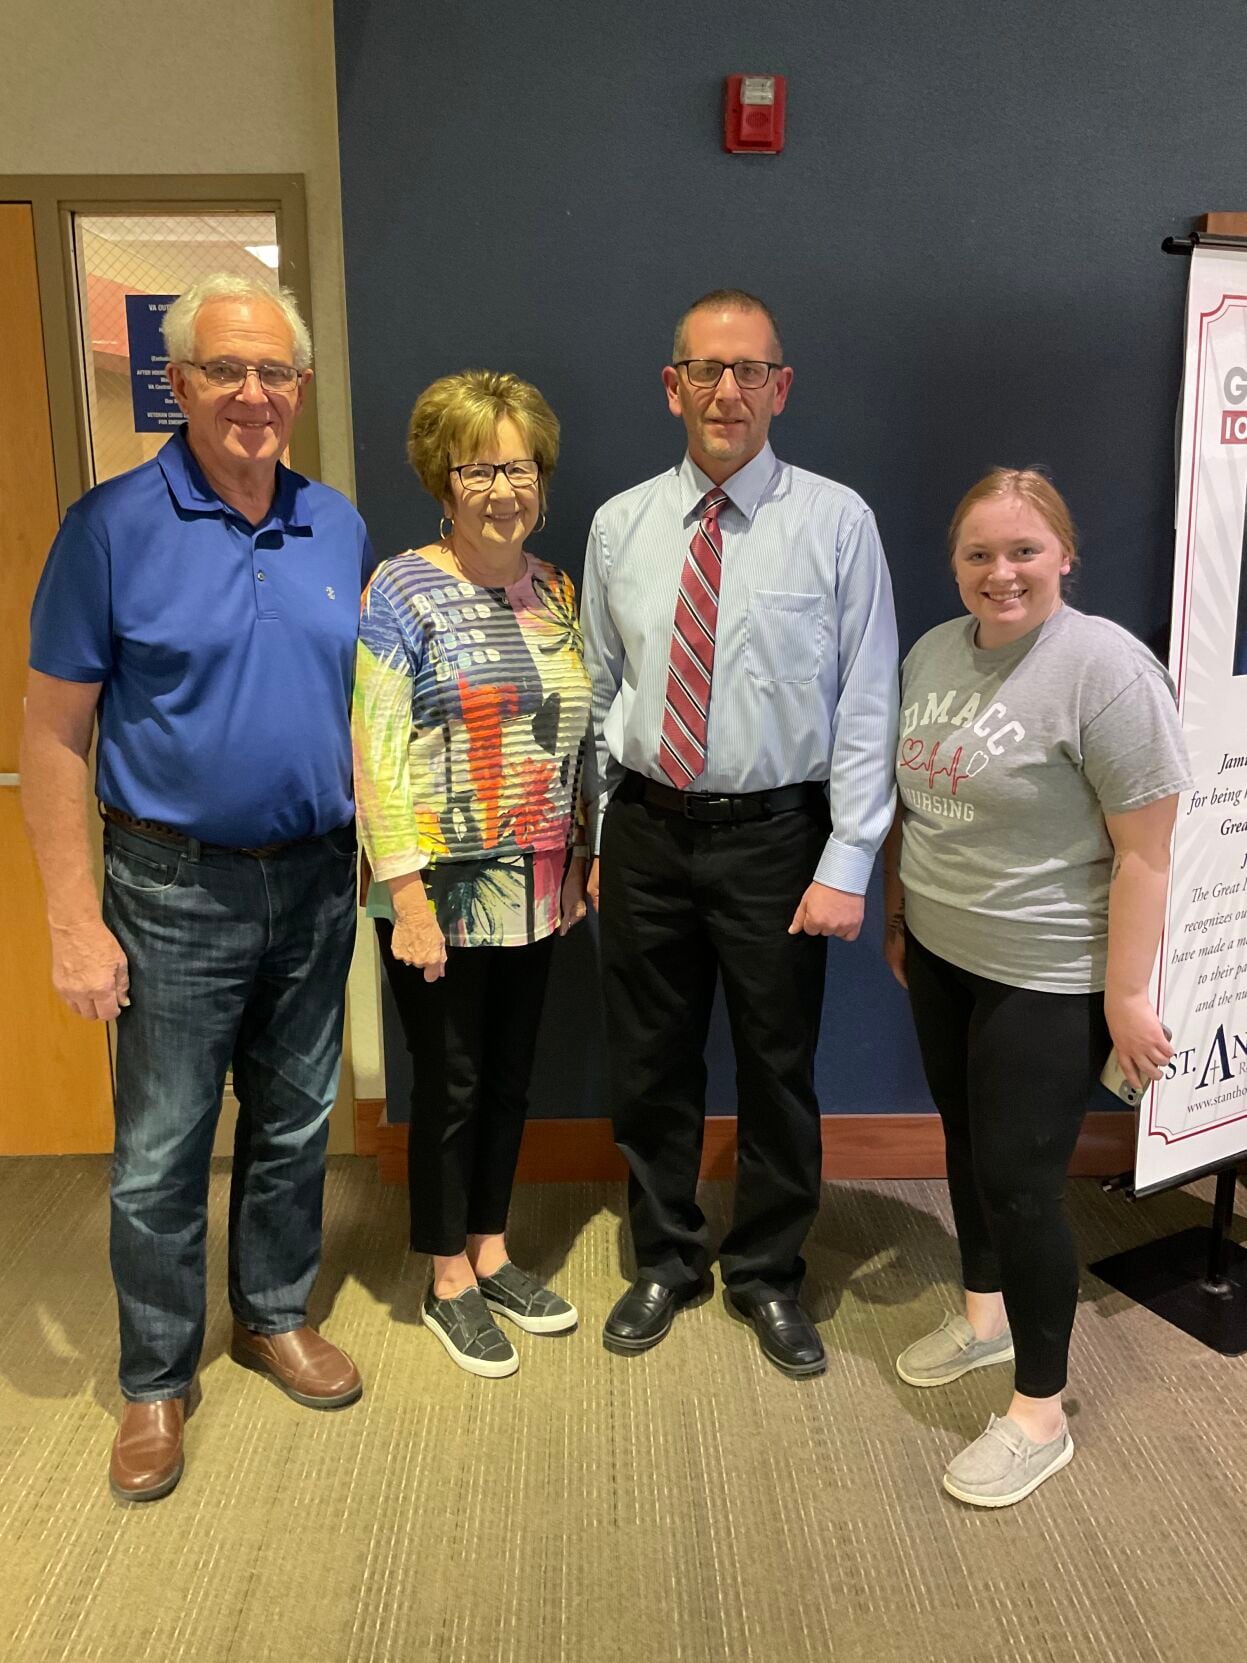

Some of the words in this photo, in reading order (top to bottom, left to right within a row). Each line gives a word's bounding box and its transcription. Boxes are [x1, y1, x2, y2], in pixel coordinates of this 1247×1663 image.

[902, 690, 1026, 755] DMACC
[902, 787, 975, 822] NURSING
[1186, 790, 1208, 815] for
[1210, 787, 1242, 806] being
[1191, 886, 1210, 903] The
[1212, 882, 1240, 898] Great
[1184, 912, 1233, 934] recognizes
[1171, 949, 1196, 964] have
[1197, 938, 1226, 957] made
[1227, 940, 1234, 950] a
[1197, 974, 1208, 985] to
[1210, 964, 1234, 981] their
[1195, 993, 1217, 1013] and
[1217, 990, 1233, 1006] the
[1165, 1047, 1197, 1080] ST.
